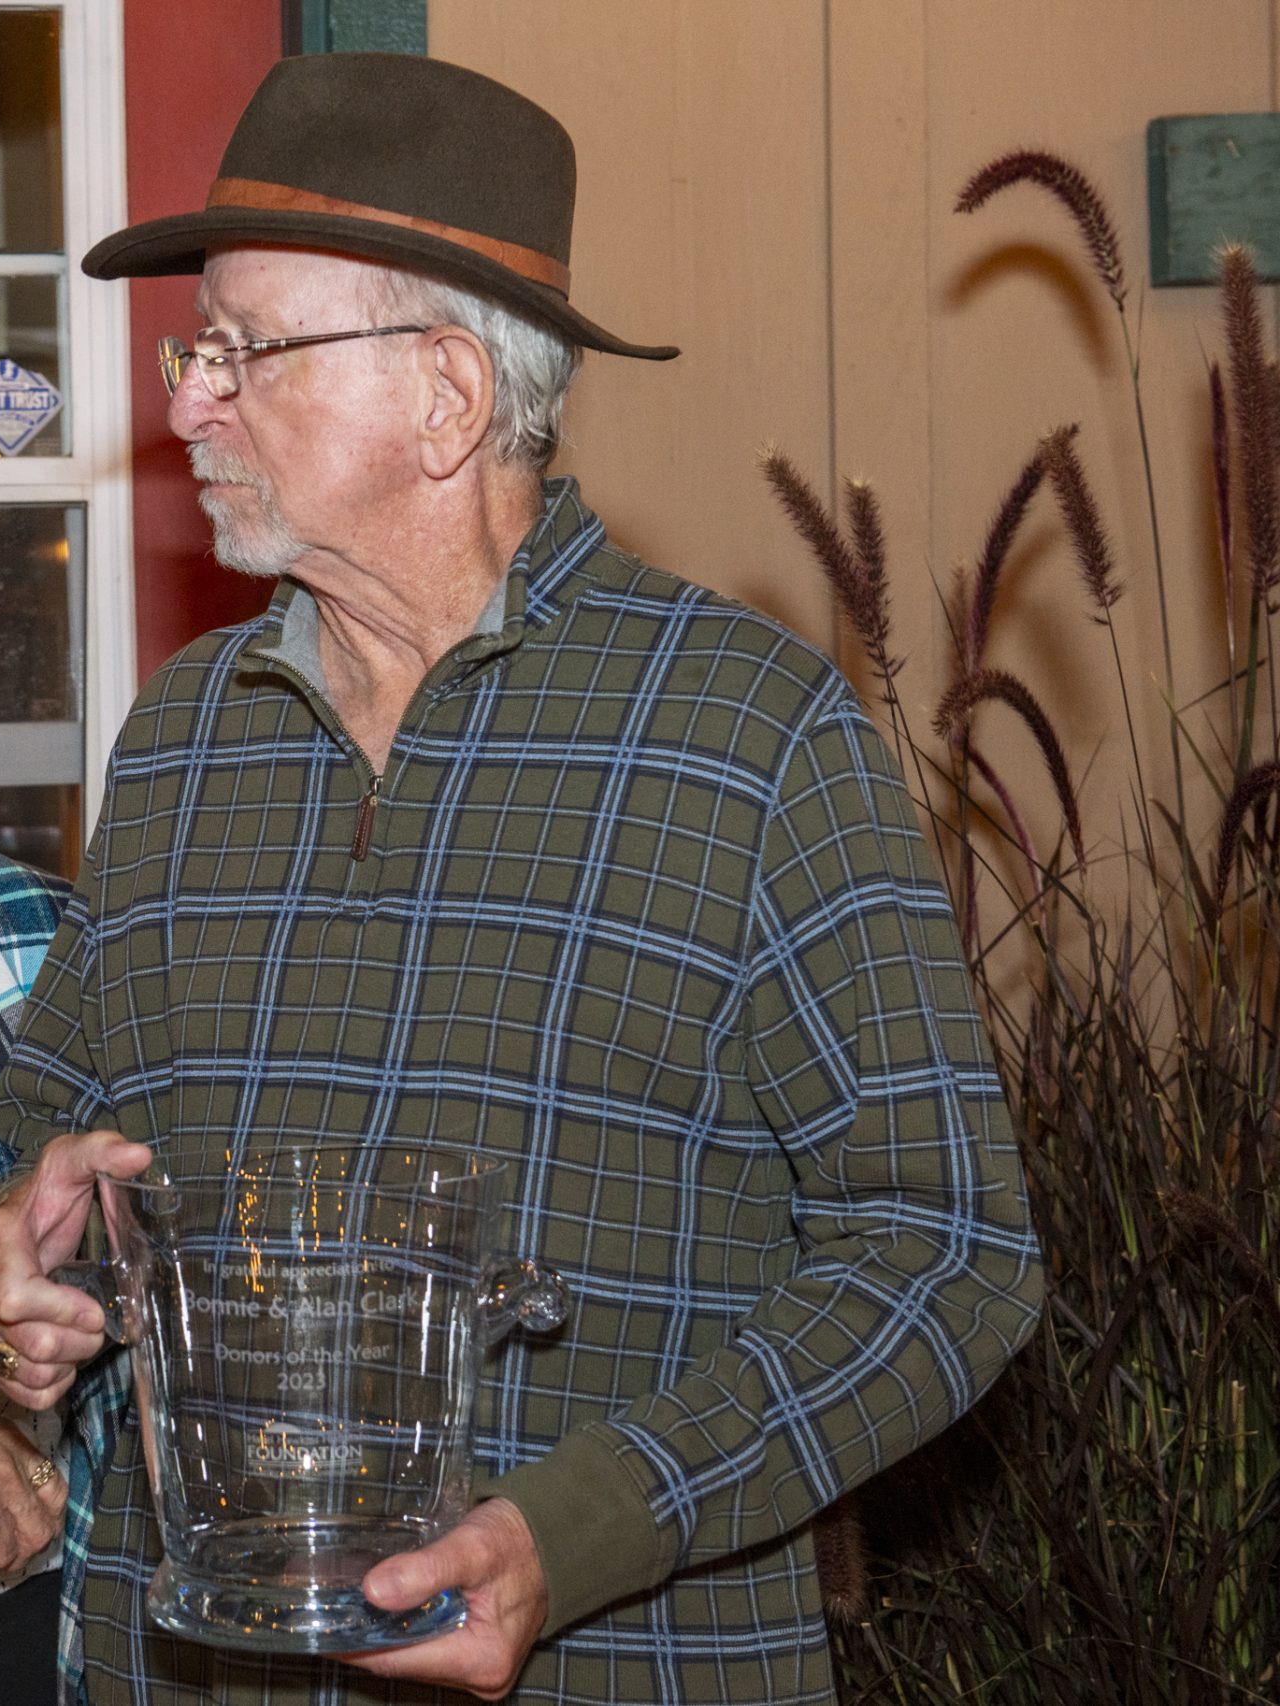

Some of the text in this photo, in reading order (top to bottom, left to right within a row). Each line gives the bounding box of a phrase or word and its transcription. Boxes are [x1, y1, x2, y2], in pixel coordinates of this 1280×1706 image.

[203, 1257, 395, 1279] In gratful appreciation to
[184, 1287, 420, 1319] Bonnie & Alan Clark
[215, 1342, 390, 1365] Donors of the Year
[277, 1372, 326, 1390] 2023
[247, 1444, 362, 1461] FOUNDATION
